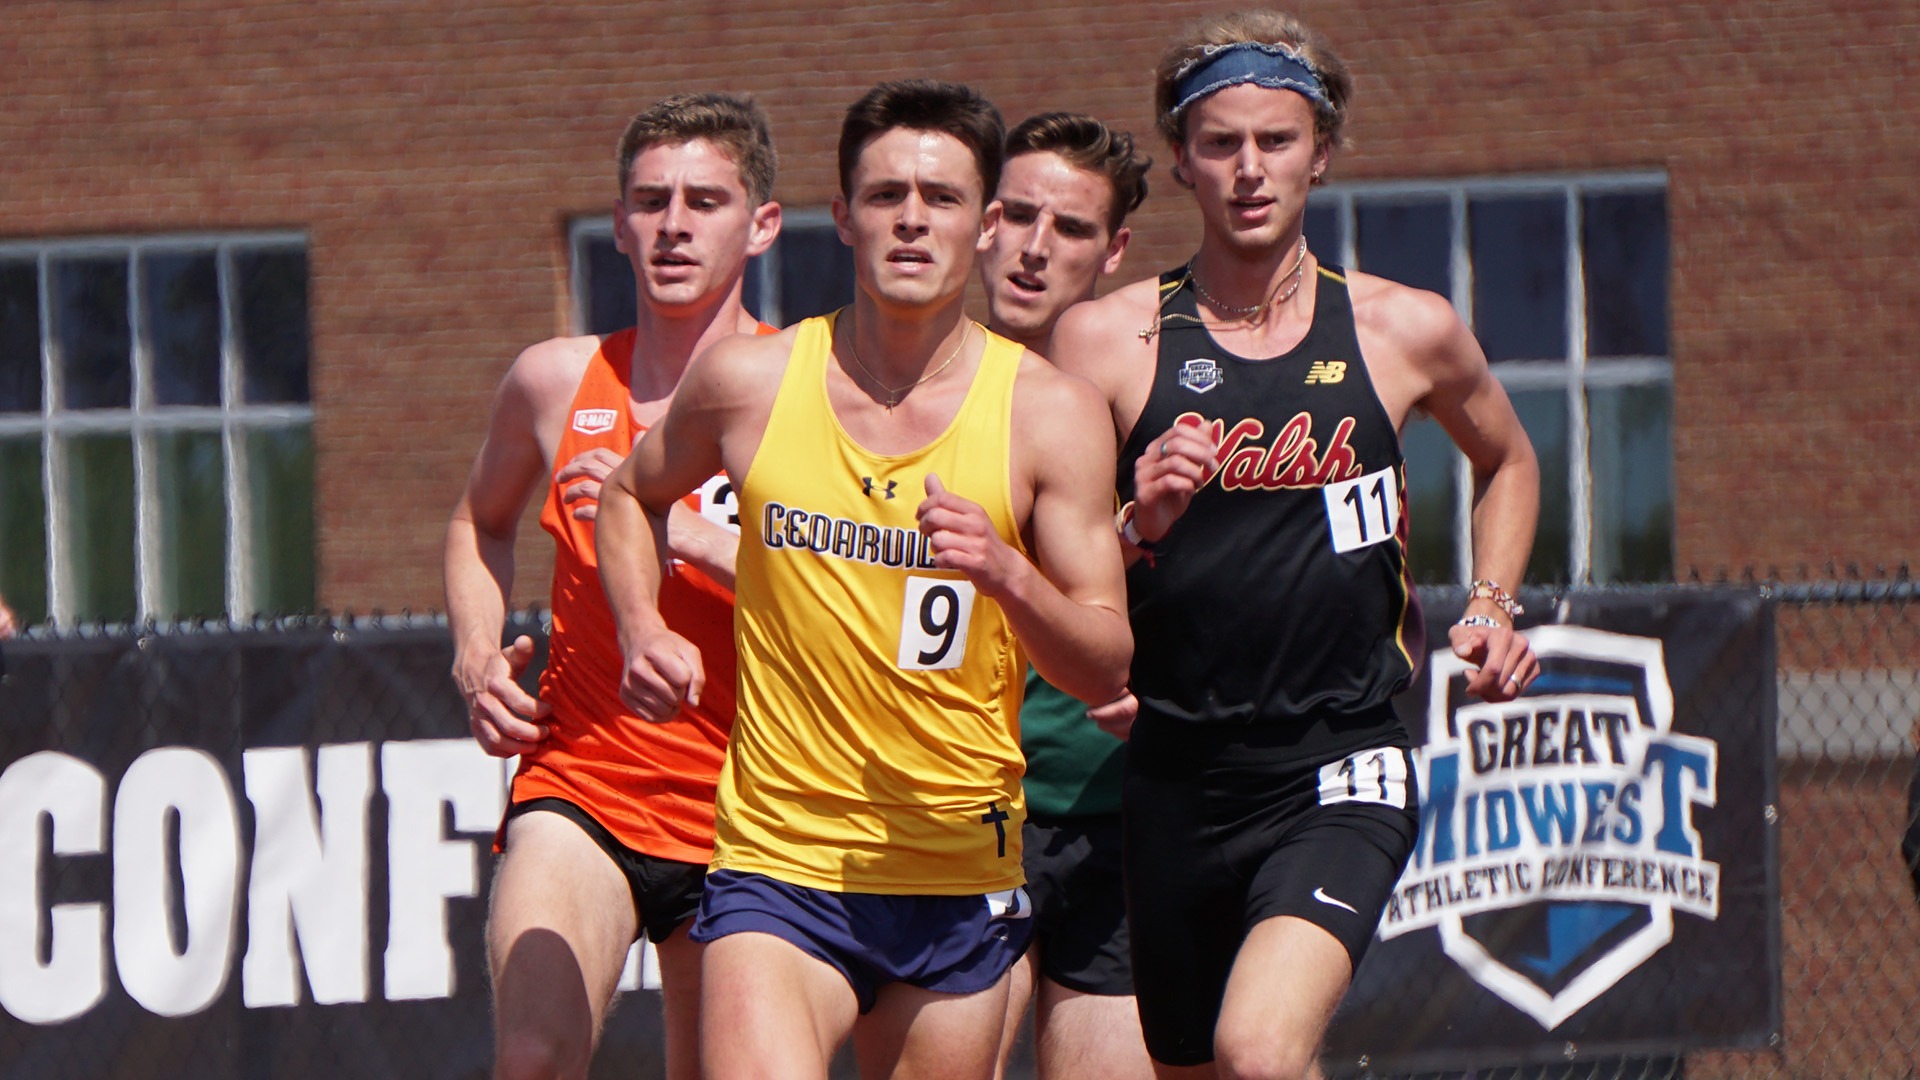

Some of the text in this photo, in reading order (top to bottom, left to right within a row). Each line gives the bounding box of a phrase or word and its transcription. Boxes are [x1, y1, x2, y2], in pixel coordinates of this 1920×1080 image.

[1304, 361, 1347, 384] NB
[764, 502, 960, 570] CEDARVIL
[1343, 476, 1391, 543] 11
[917, 584, 960, 666] 9
[1338, 753, 1388, 800] 11
[1467, 711, 1630, 776] GREAT
[1415, 742, 1708, 869] MIDWEST
[0, 737, 520, 1025] CONF
[1388, 854, 1715, 924] ATHLETIC CONFERENCE
